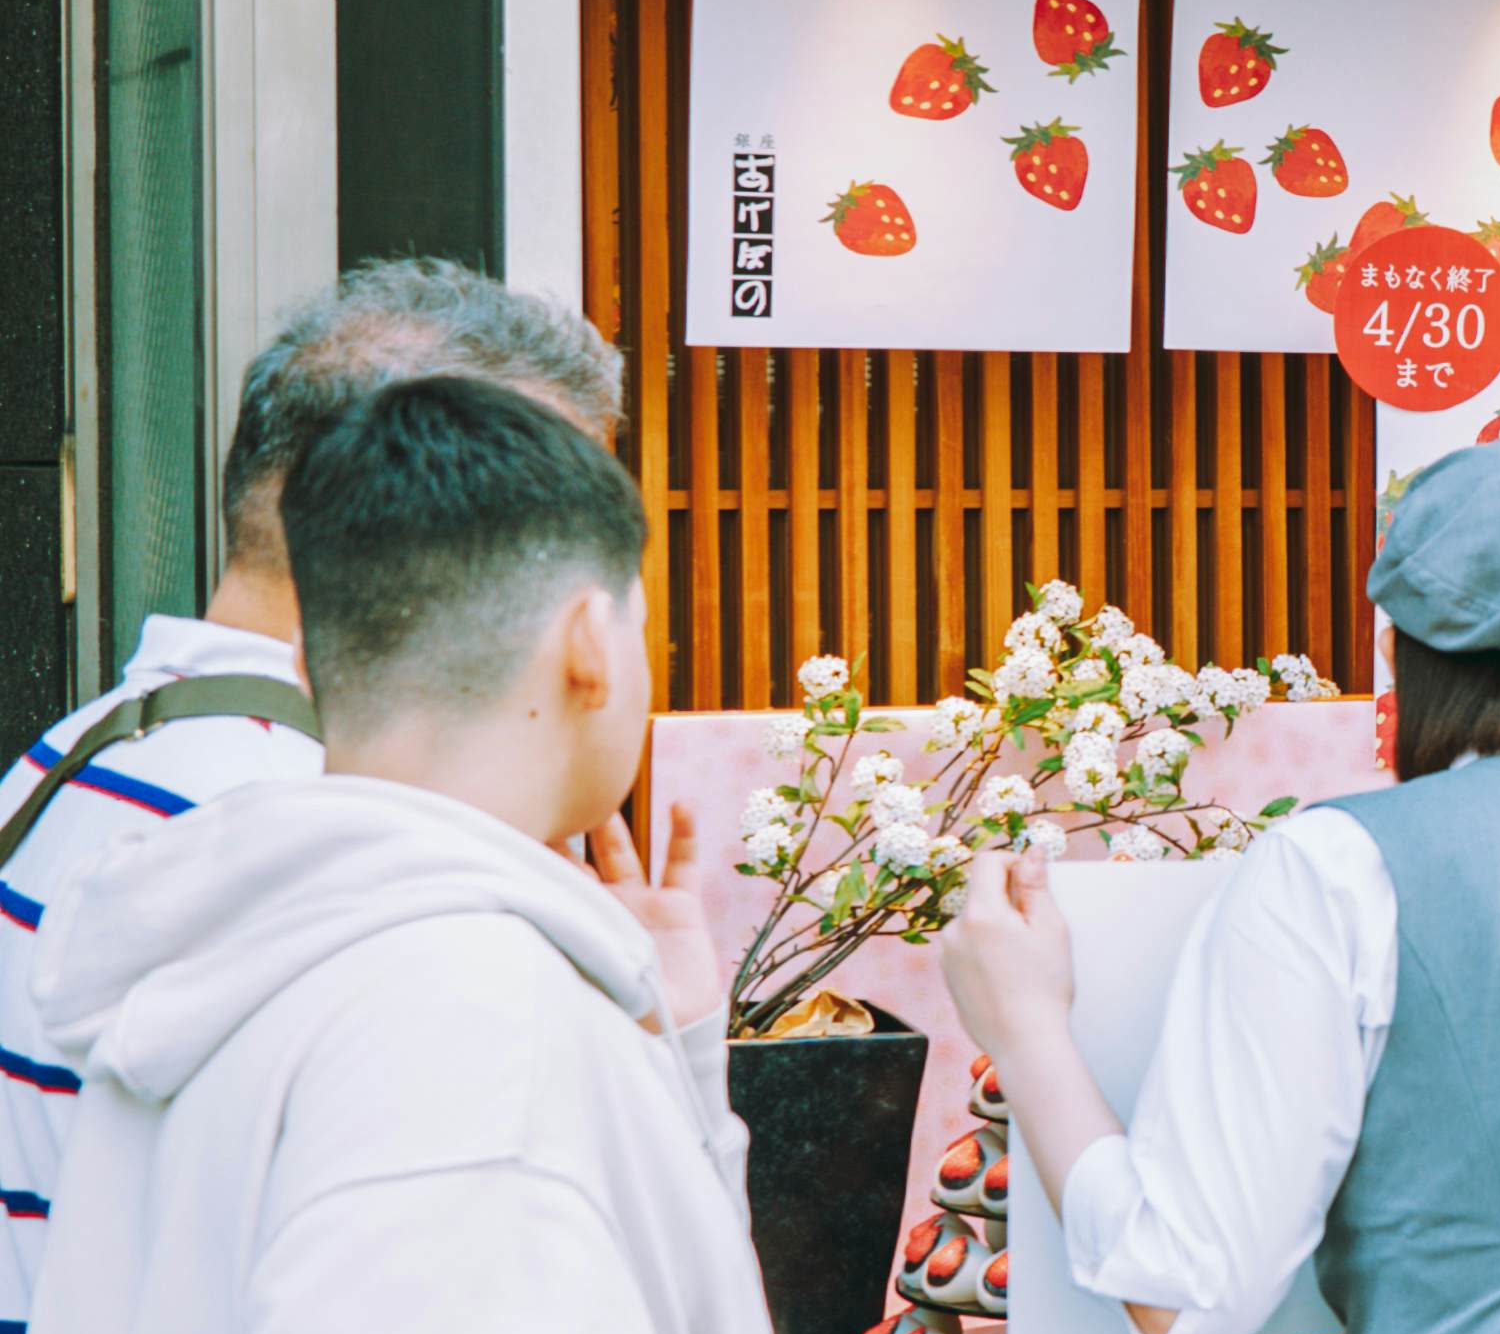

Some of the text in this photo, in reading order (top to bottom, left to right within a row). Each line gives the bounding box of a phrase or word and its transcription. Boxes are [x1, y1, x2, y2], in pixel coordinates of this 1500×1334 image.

[735, 133, 774, 148] 銀座
[732, 154, 774, 316] あけぼの
[1361, 264, 1495, 293] まもなく終了
[1363, 300, 1486, 354] 4/30
[1396, 358, 1454, 388] まで
